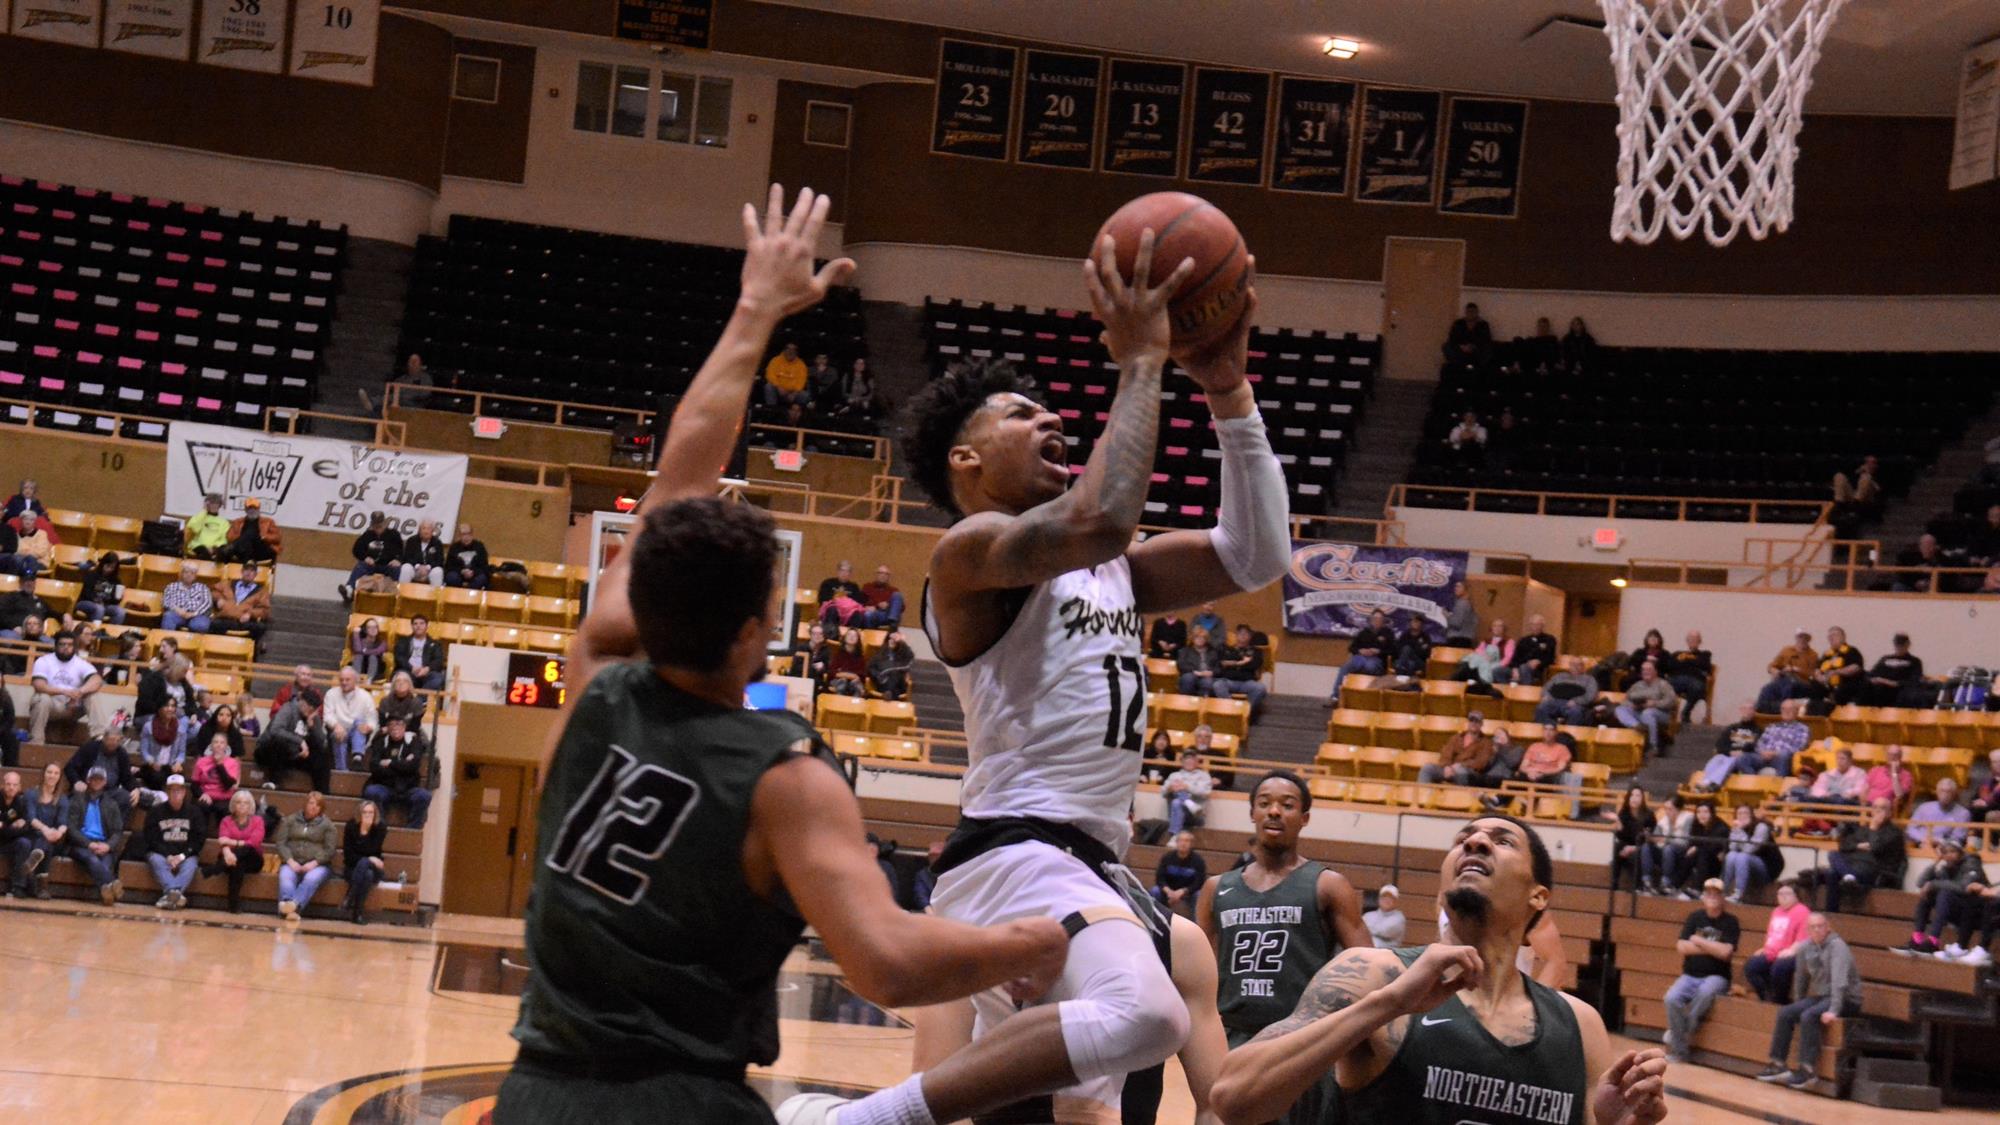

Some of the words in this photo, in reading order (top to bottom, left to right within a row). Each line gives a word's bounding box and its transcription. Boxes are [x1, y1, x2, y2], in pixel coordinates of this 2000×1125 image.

[323, 4, 352, 29] 10
[959, 82, 990, 107] 23
[1043, 94, 1075, 118] 20
[1130, 102, 1159, 126] 13
[1213, 111, 1244, 135] 42
[1297, 120, 1327, 143] 31
[1394, 130, 1405, 151] 1
[1468, 140, 1500, 163] 50
[101, 451, 123, 471] 10
[350, 445, 427, 478] Voice
[207, 451, 247, 510] Mix
[339, 477, 377, 501] of
[383, 480, 430, 508] the
[319, 501, 444, 537] Hones
[531, 501, 542, 517] 9
[1488, 589, 1498, 605] 7
[1103, 654, 1144, 752] 12
[545, 744, 701, 906] 12
[1220, 906, 1303, 928] NORTHEASTERN
[1231, 930, 1289, 974] 22
[1240, 978, 1275, 996] STATE
[1422, 1065, 1574, 1125] NORTHEASTERN
